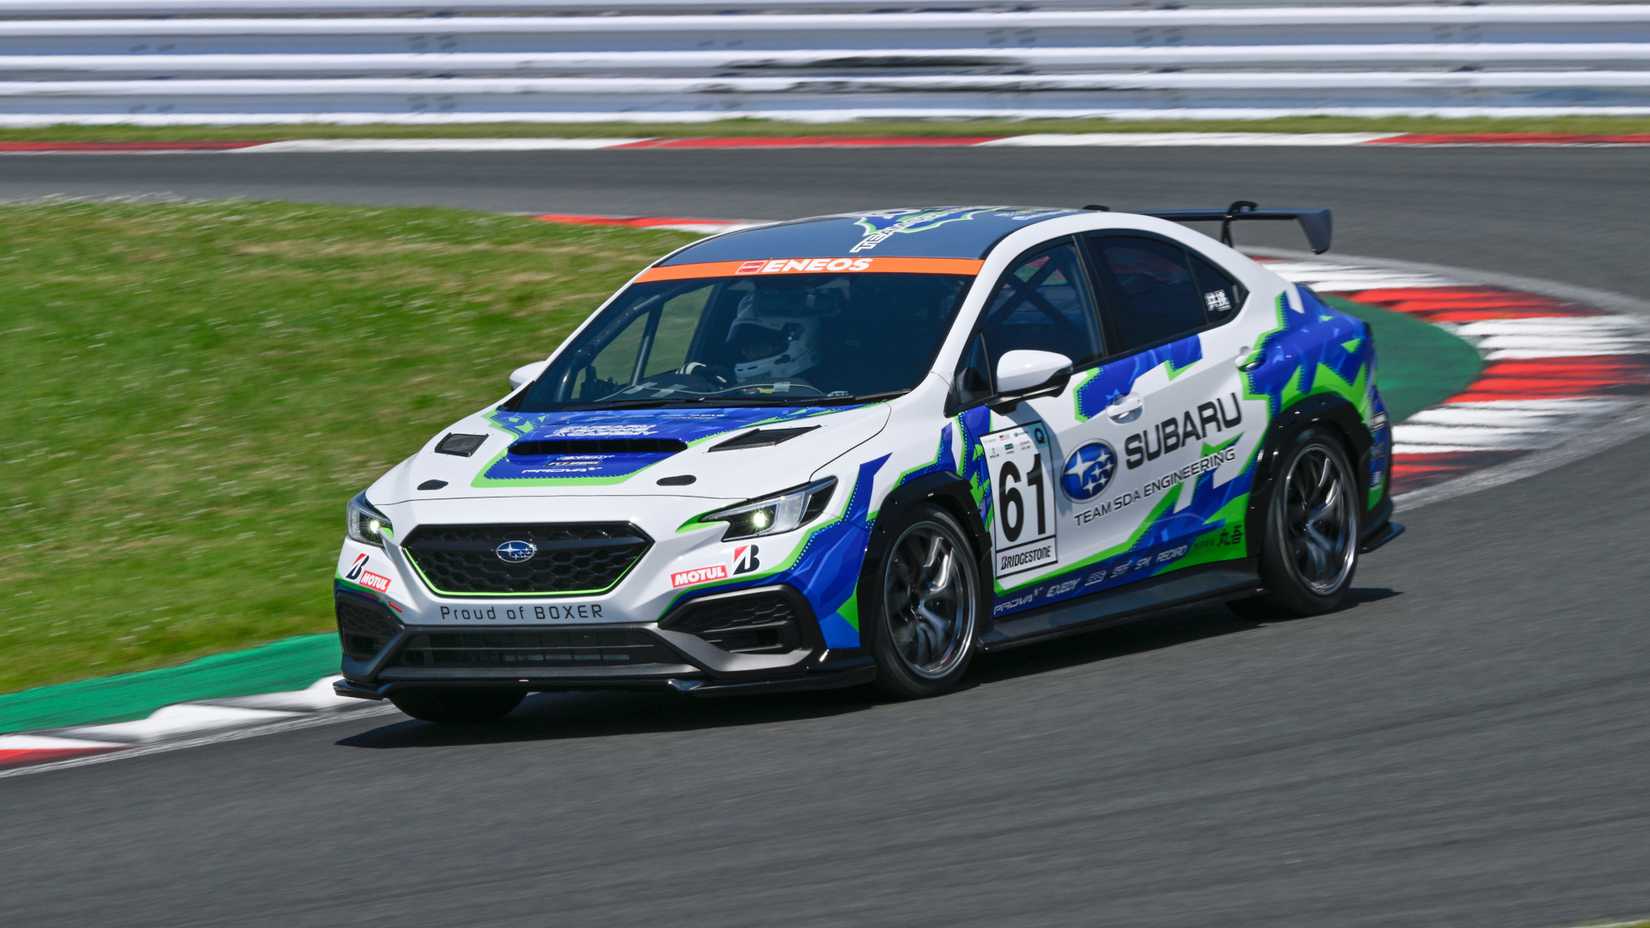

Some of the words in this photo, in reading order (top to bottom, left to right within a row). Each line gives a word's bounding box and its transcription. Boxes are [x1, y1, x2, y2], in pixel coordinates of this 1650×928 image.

[761, 257, 873, 273] ENEOS
[1034, 427, 1046, 444] Q
[1124, 392, 1242, 470] SUBARU
[998, 453, 1047, 542] 61
[1074, 502, 1112, 526] TEAM
[1114, 490, 1141, 511] SDA
[1143, 448, 1237, 498] ENGINEERING
[1001, 545, 1052, 571] BRIDGESTONE
[360, 571, 389, 592] MOTUL
[674, 565, 726, 586] MOTUL
[440, 606, 496, 620] Proud
[506, 606, 529, 620] of
[534, 604, 604, 620] BOXER
